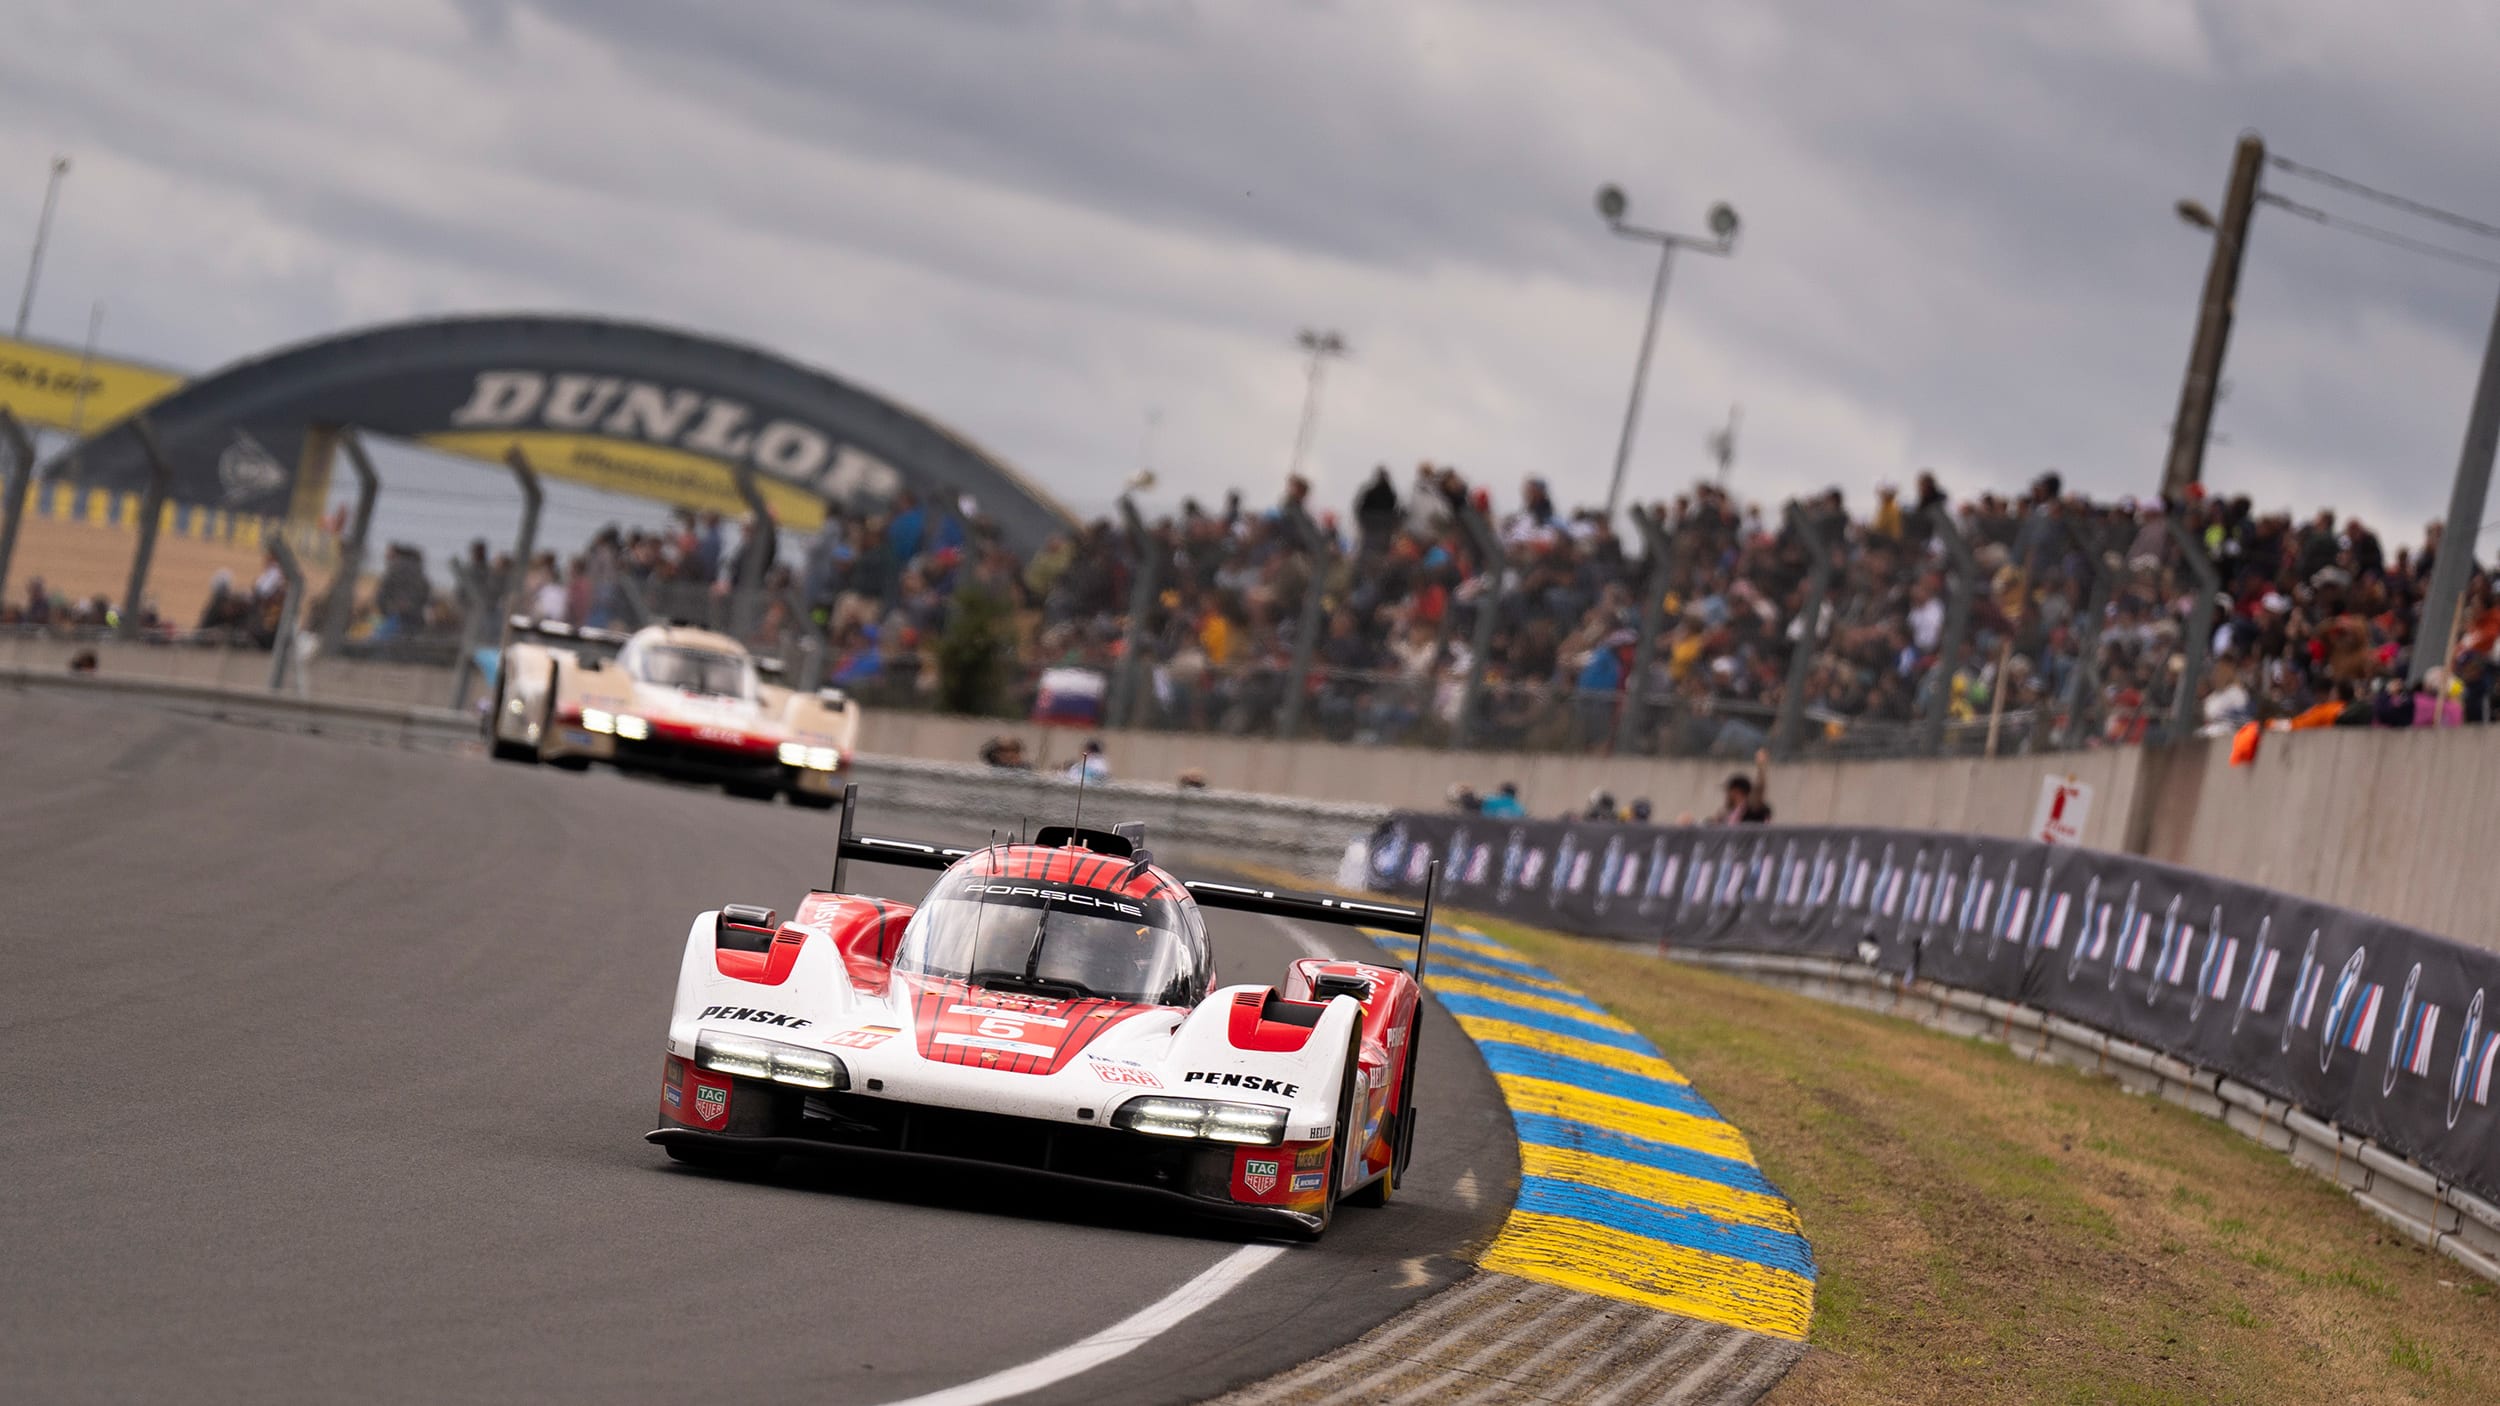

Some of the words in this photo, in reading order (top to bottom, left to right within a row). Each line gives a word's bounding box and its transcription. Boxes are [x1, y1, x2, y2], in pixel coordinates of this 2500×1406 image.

[449, 370, 900, 500] DUNLOP
[964, 884, 1143, 917] PORSCHE
[697, 1005, 813, 1029] PENSKE
[977, 1017, 1025, 1039] 5
[1095, 1064, 1150, 1077] HYPER
[1102, 1071, 1158, 1086] CAR
[1184, 1071, 1300, 1098] PENSKE
[700, 1088, 723, 1102] TAG
[696, 1101, 722, 1118] HEUER
[1249, 1163, 1275, 1174] TAG
[1246, 1175, 1277, 1192] HEUER
